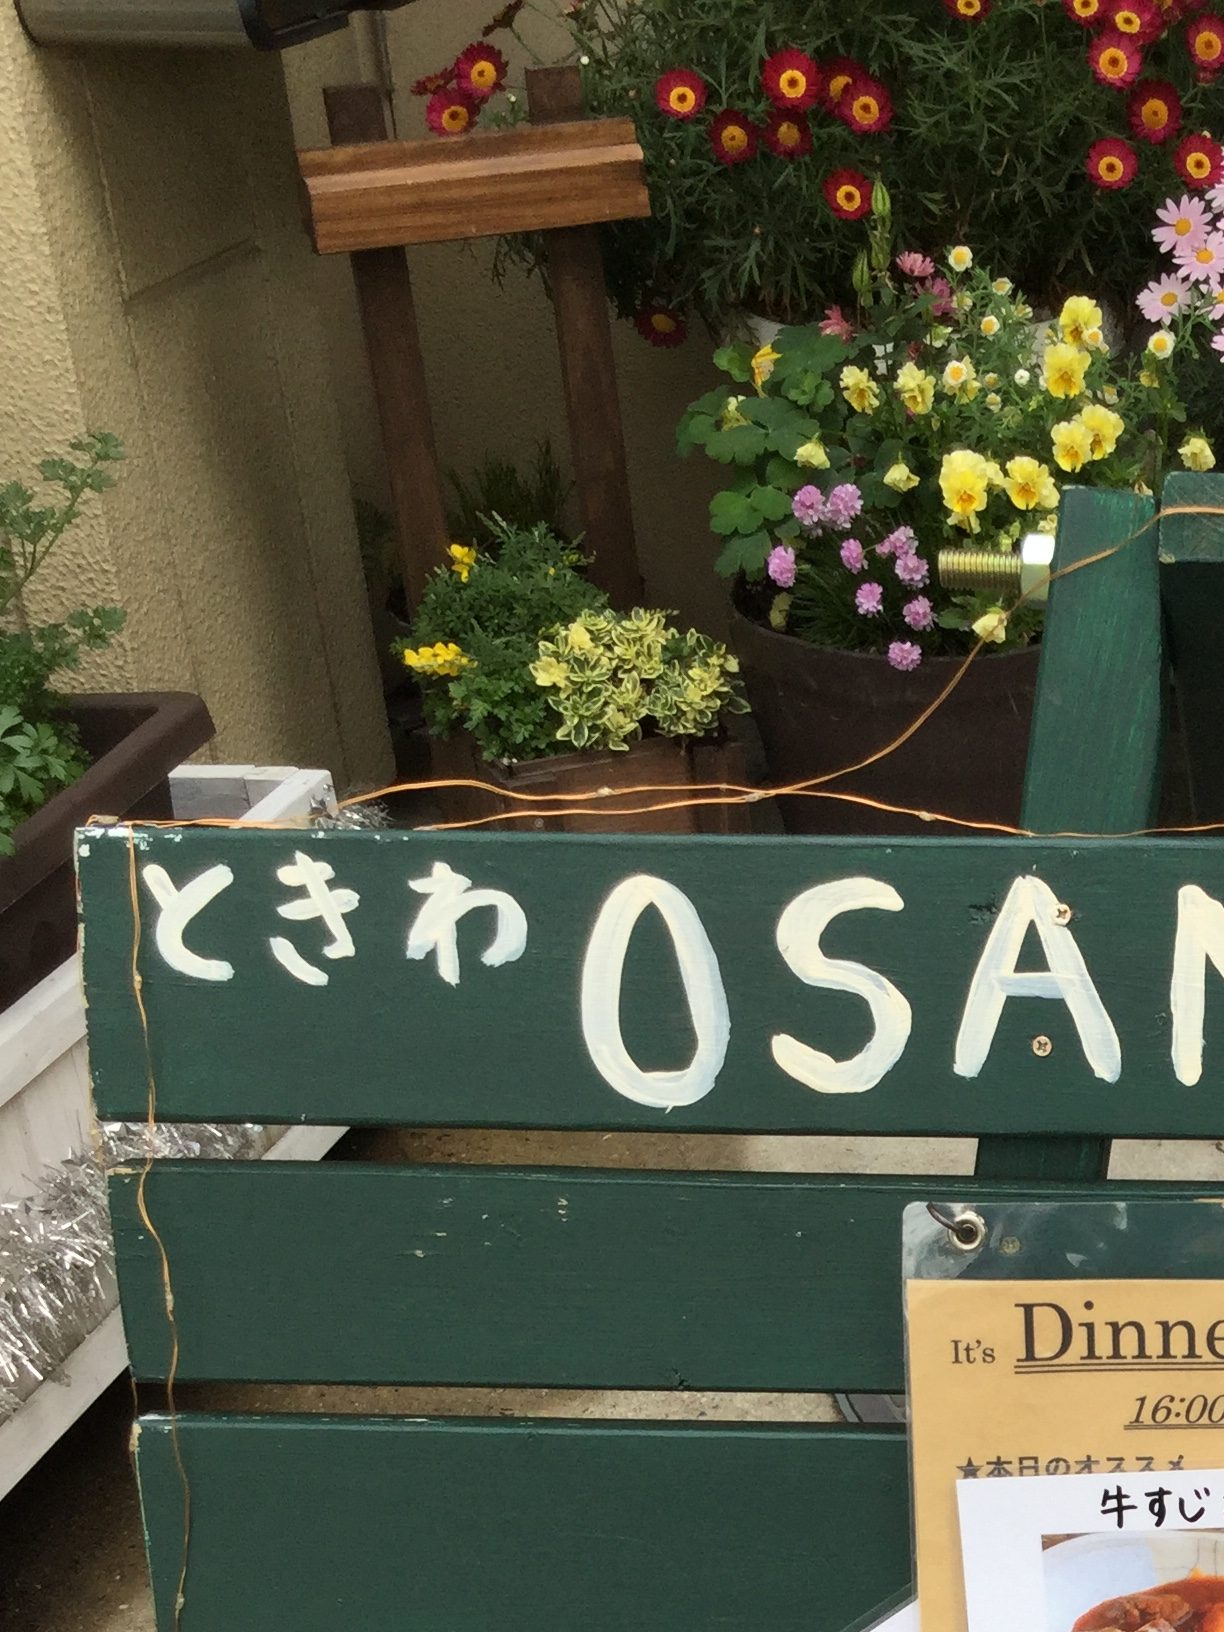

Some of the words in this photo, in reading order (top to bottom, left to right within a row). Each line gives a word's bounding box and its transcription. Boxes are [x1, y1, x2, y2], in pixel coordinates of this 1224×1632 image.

[143, 850, 528, 987] ときわ
[950, 1337, 997, 1366] It's
